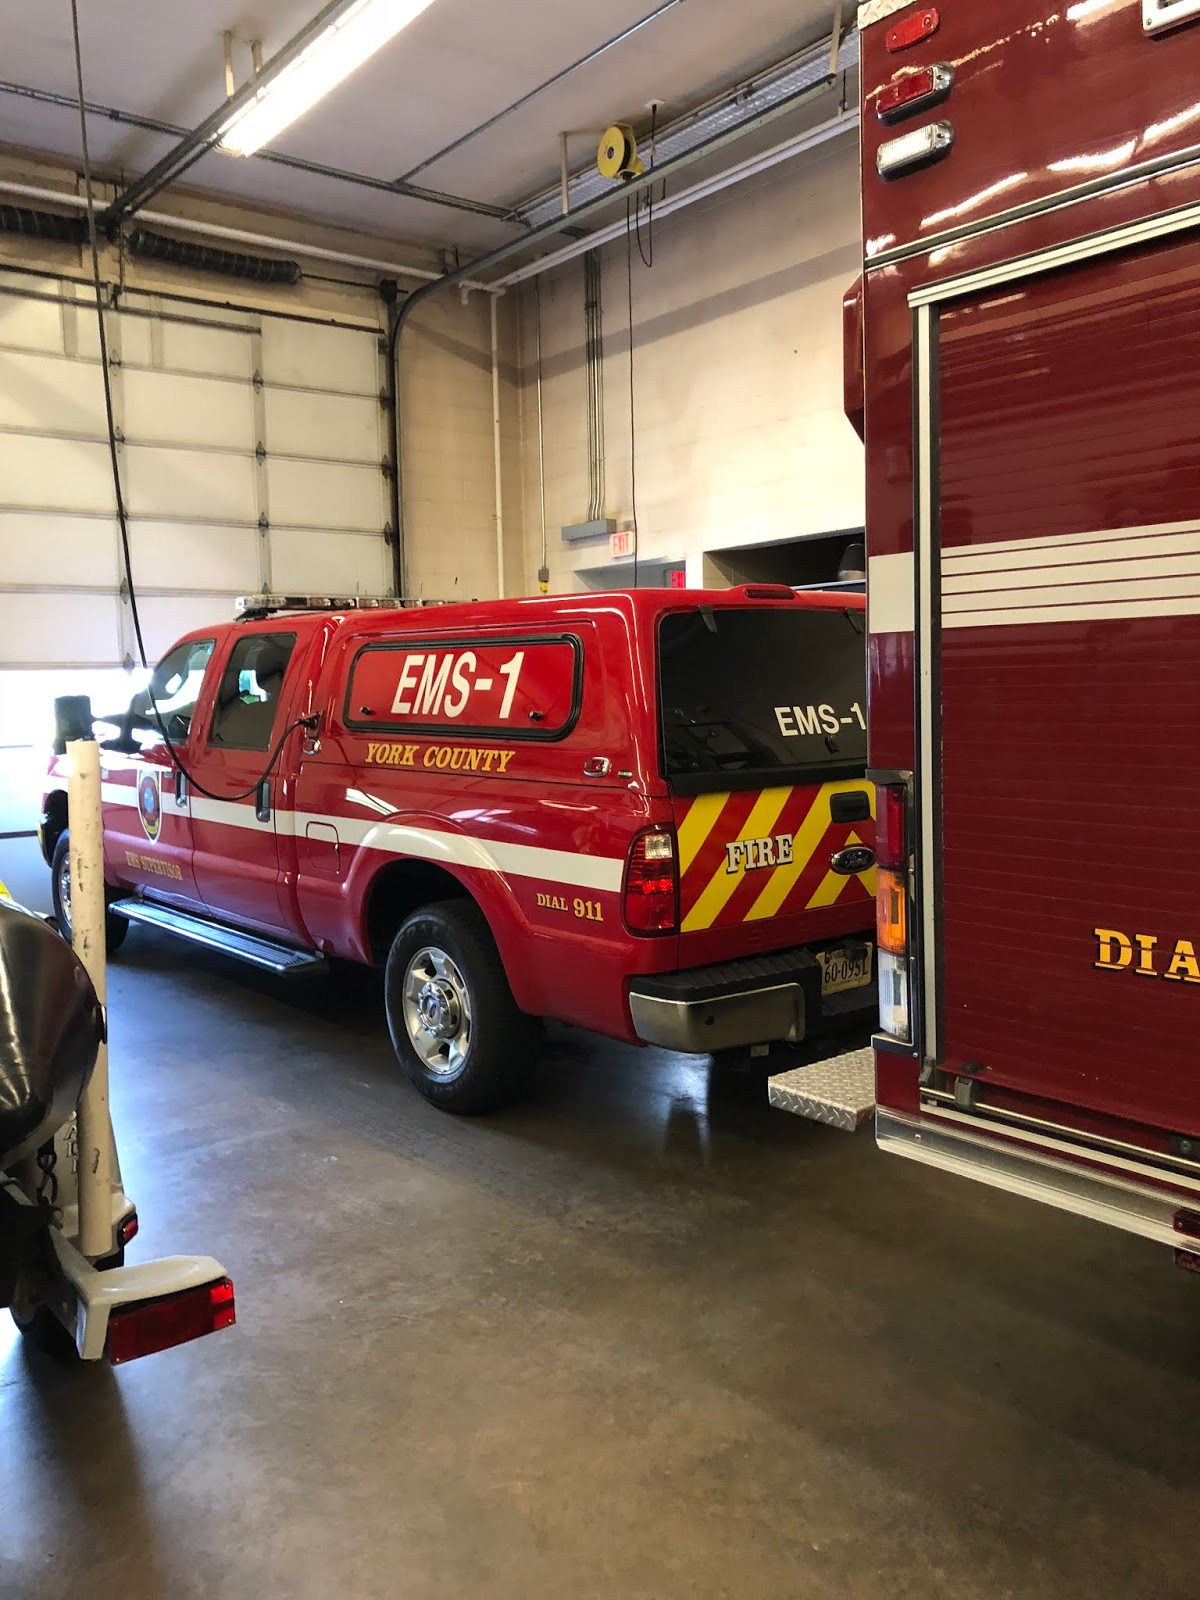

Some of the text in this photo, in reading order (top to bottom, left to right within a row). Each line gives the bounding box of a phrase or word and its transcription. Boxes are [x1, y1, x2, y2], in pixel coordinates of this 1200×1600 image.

[612, 533, 630, 555] EXIT
[390, 651, 525, 719] EMS-1
[774, 702, 867, 737] EMS-1
[365, 742, 516, 773] YORK COUNTY
[725, 833, 794, 874] FIRE
[536, 893, 604, 922] DIAL 911
